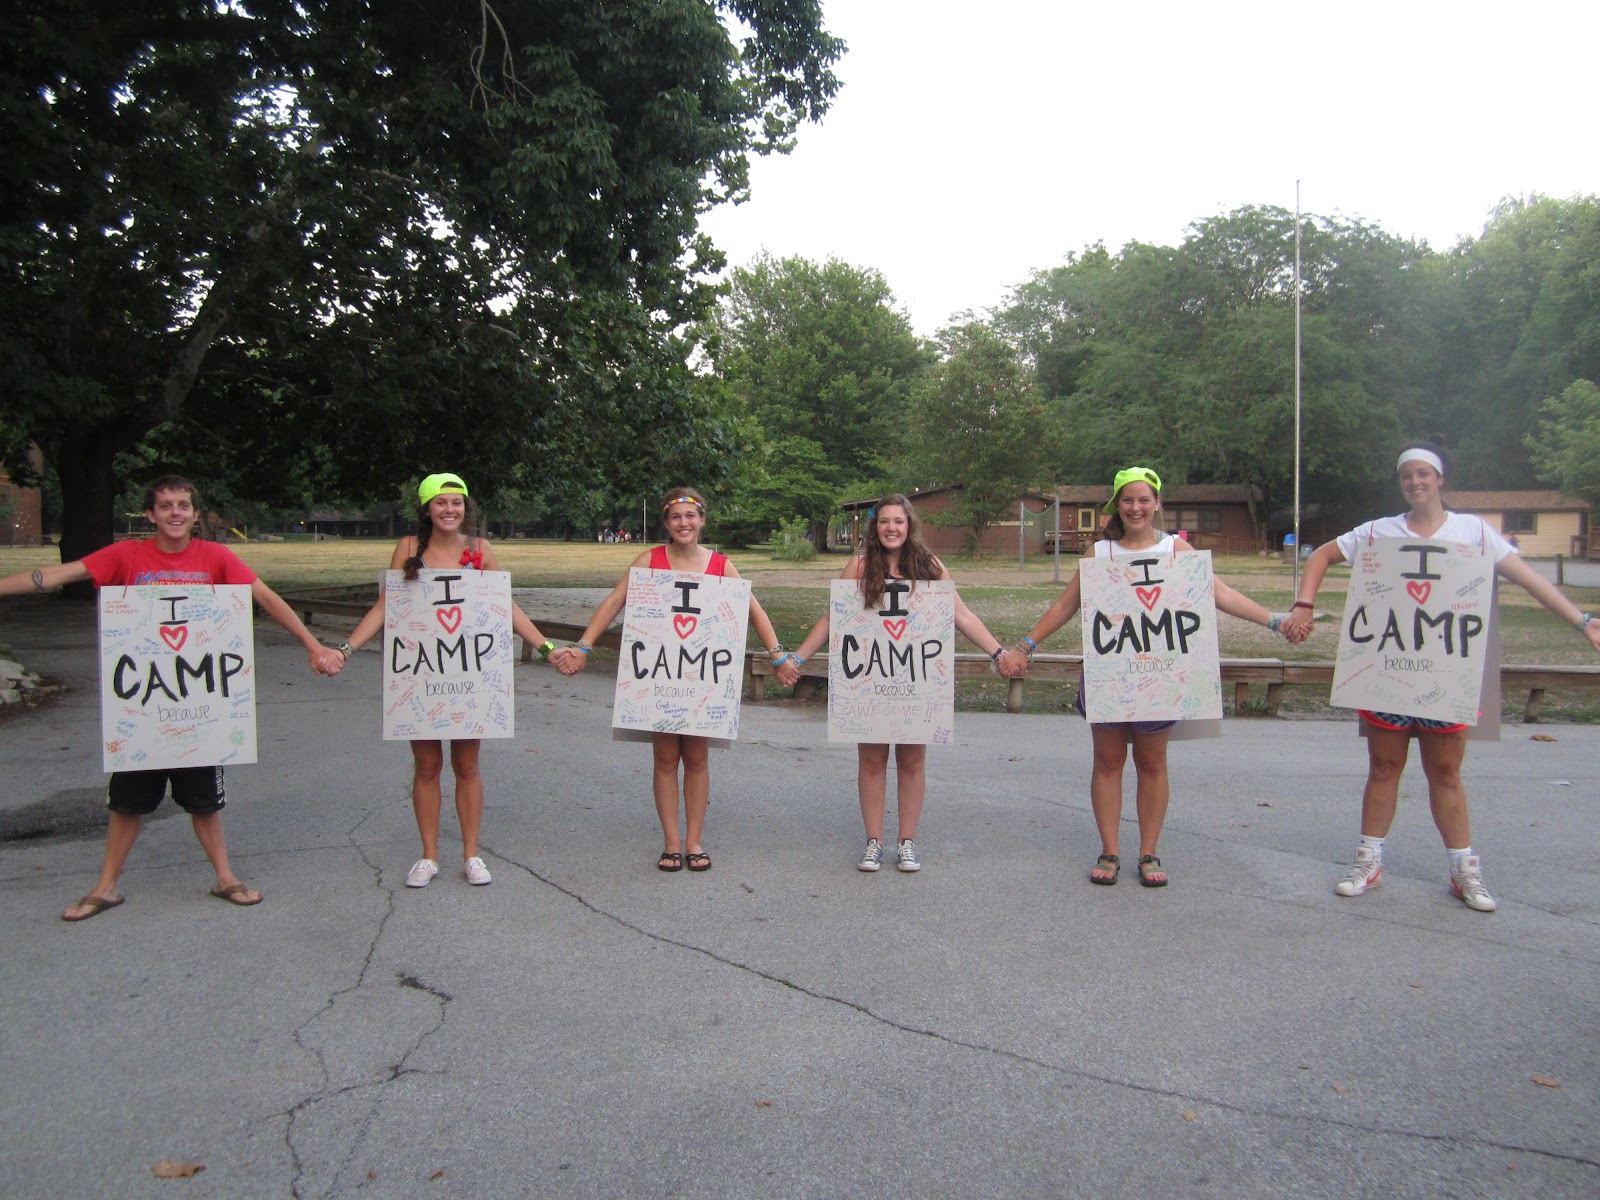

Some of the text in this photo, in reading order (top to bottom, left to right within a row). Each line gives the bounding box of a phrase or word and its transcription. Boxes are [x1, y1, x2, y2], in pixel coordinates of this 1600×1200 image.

[1127, 558, 1164, 587] I
[1398, 545, 1448, 580] I
[432, 575, 465, 606] I
[671, 581, 702, 615] I
[878, 582, 910, 617] I
[158, 596, 189, 625] I
[1093, 608, 1201, 656] CAMP
[1349, 604, 1483, 658] CAMP
[392, 633, 493, 675] CAMP
[631, 641, 732, 684] CAMP
[841, 634, 943, 682] CAMP
[113, 651, 244, 706] CAMP
